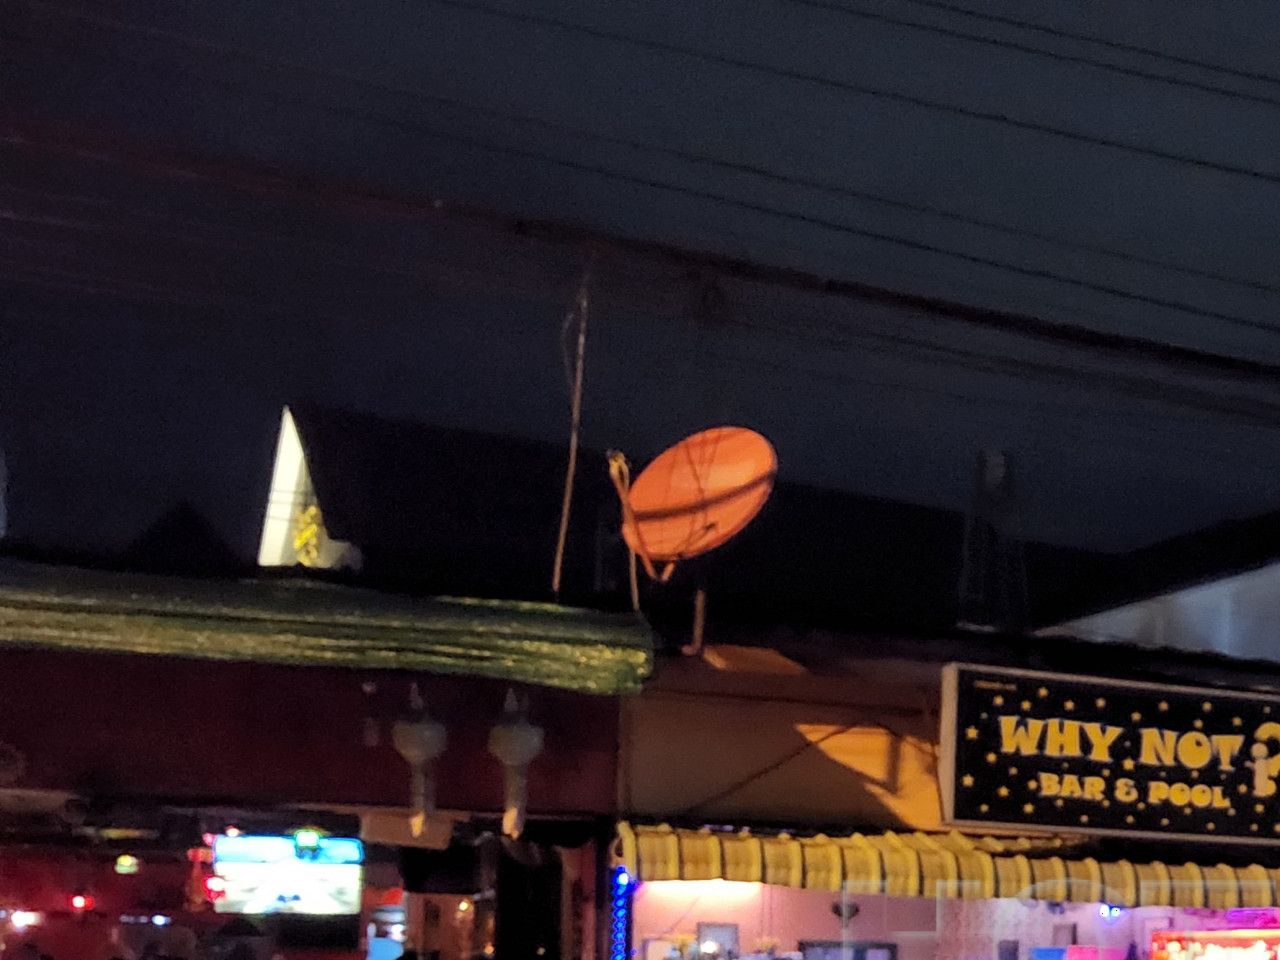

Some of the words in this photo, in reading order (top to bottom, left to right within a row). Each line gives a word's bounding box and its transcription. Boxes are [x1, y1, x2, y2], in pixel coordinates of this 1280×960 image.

[998, 715, 1123, 763] WHY
[1138, 726, 1245, 771] NOT
[1037, 772, 1107, 801] BAR
[1114, 777, 1139, 802] &
[1147, 780, 1232, 809] POOL
